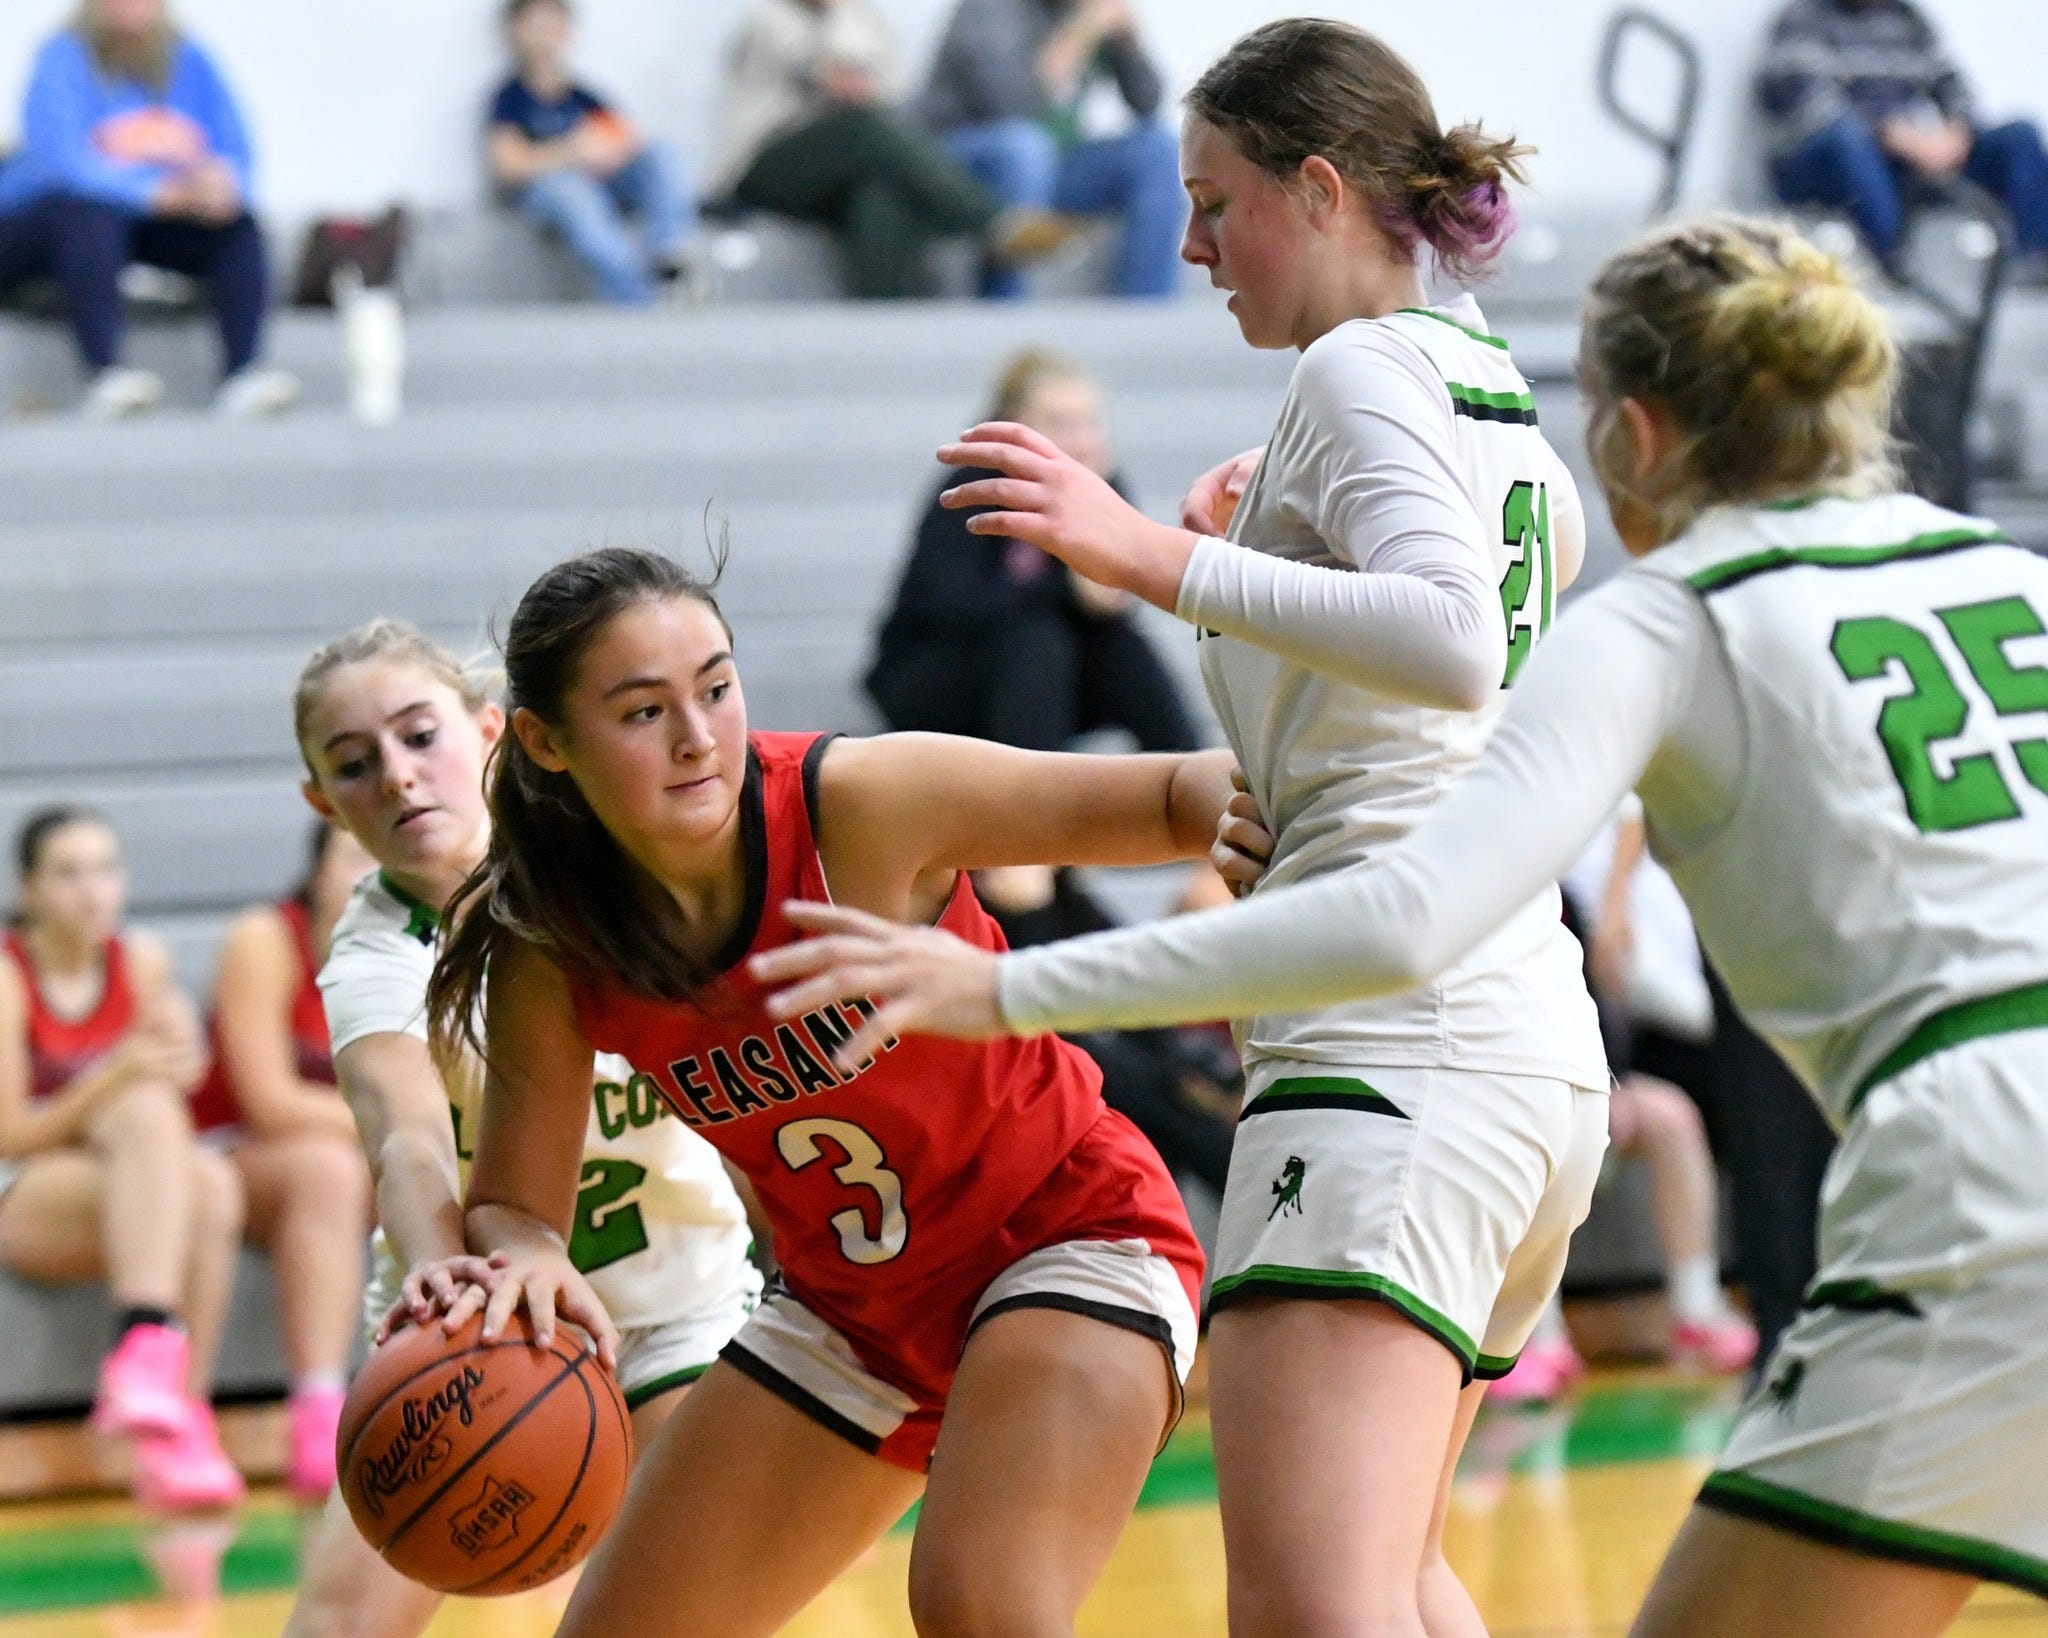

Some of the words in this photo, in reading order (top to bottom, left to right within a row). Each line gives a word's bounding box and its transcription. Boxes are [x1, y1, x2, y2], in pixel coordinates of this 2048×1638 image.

[1829, 595, 2047, 834] 25
[775, 1117, 908, 1265] 3
[358, 1365, 484, 1518] Rawlings
